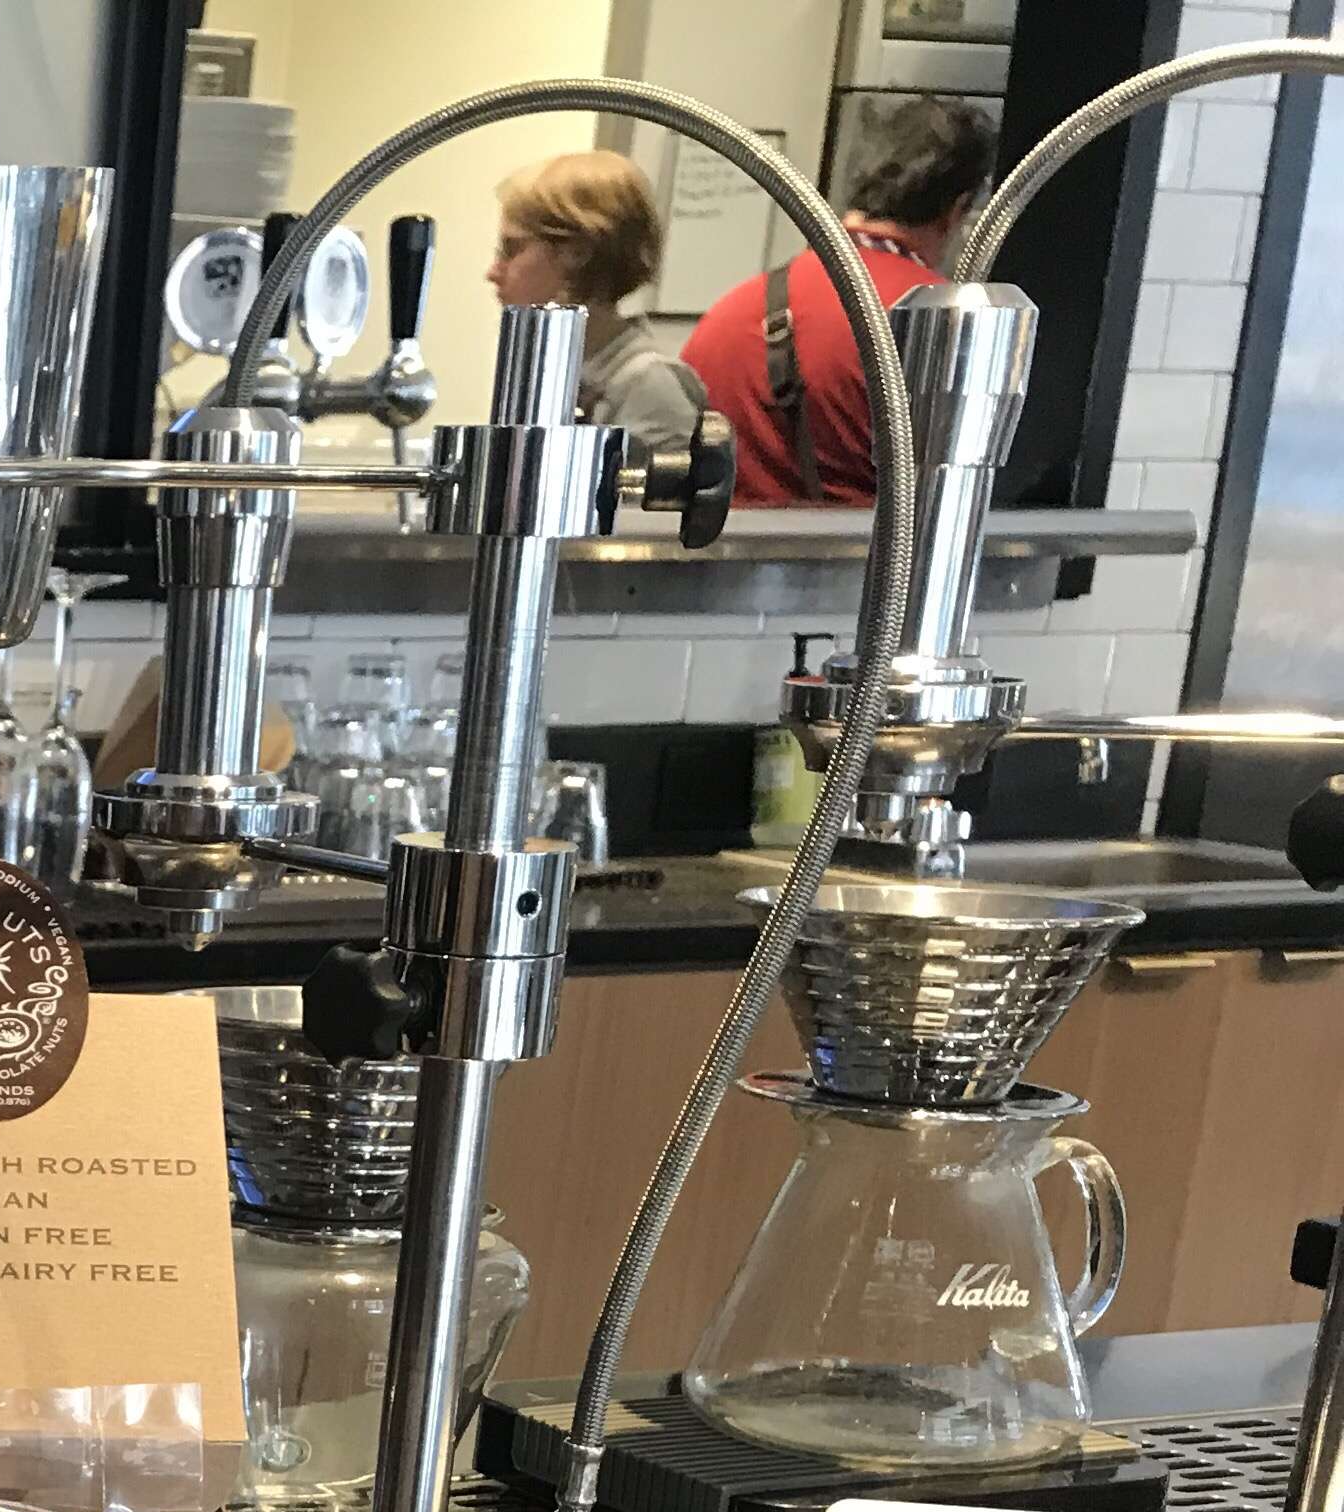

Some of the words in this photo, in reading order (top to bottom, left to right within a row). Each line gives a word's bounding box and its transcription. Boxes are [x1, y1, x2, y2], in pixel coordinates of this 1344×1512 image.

[46, 916, 74, 967] VEGAN
[43, 1016, 69, 1057] NUTS
[37, 1156, 198, 1177] ROASTED
[24, 1226, 113, 1247] FREE
[89, 1263, 179, 1283] FREE
[936, 1263, 1030, 1312] Kalita
